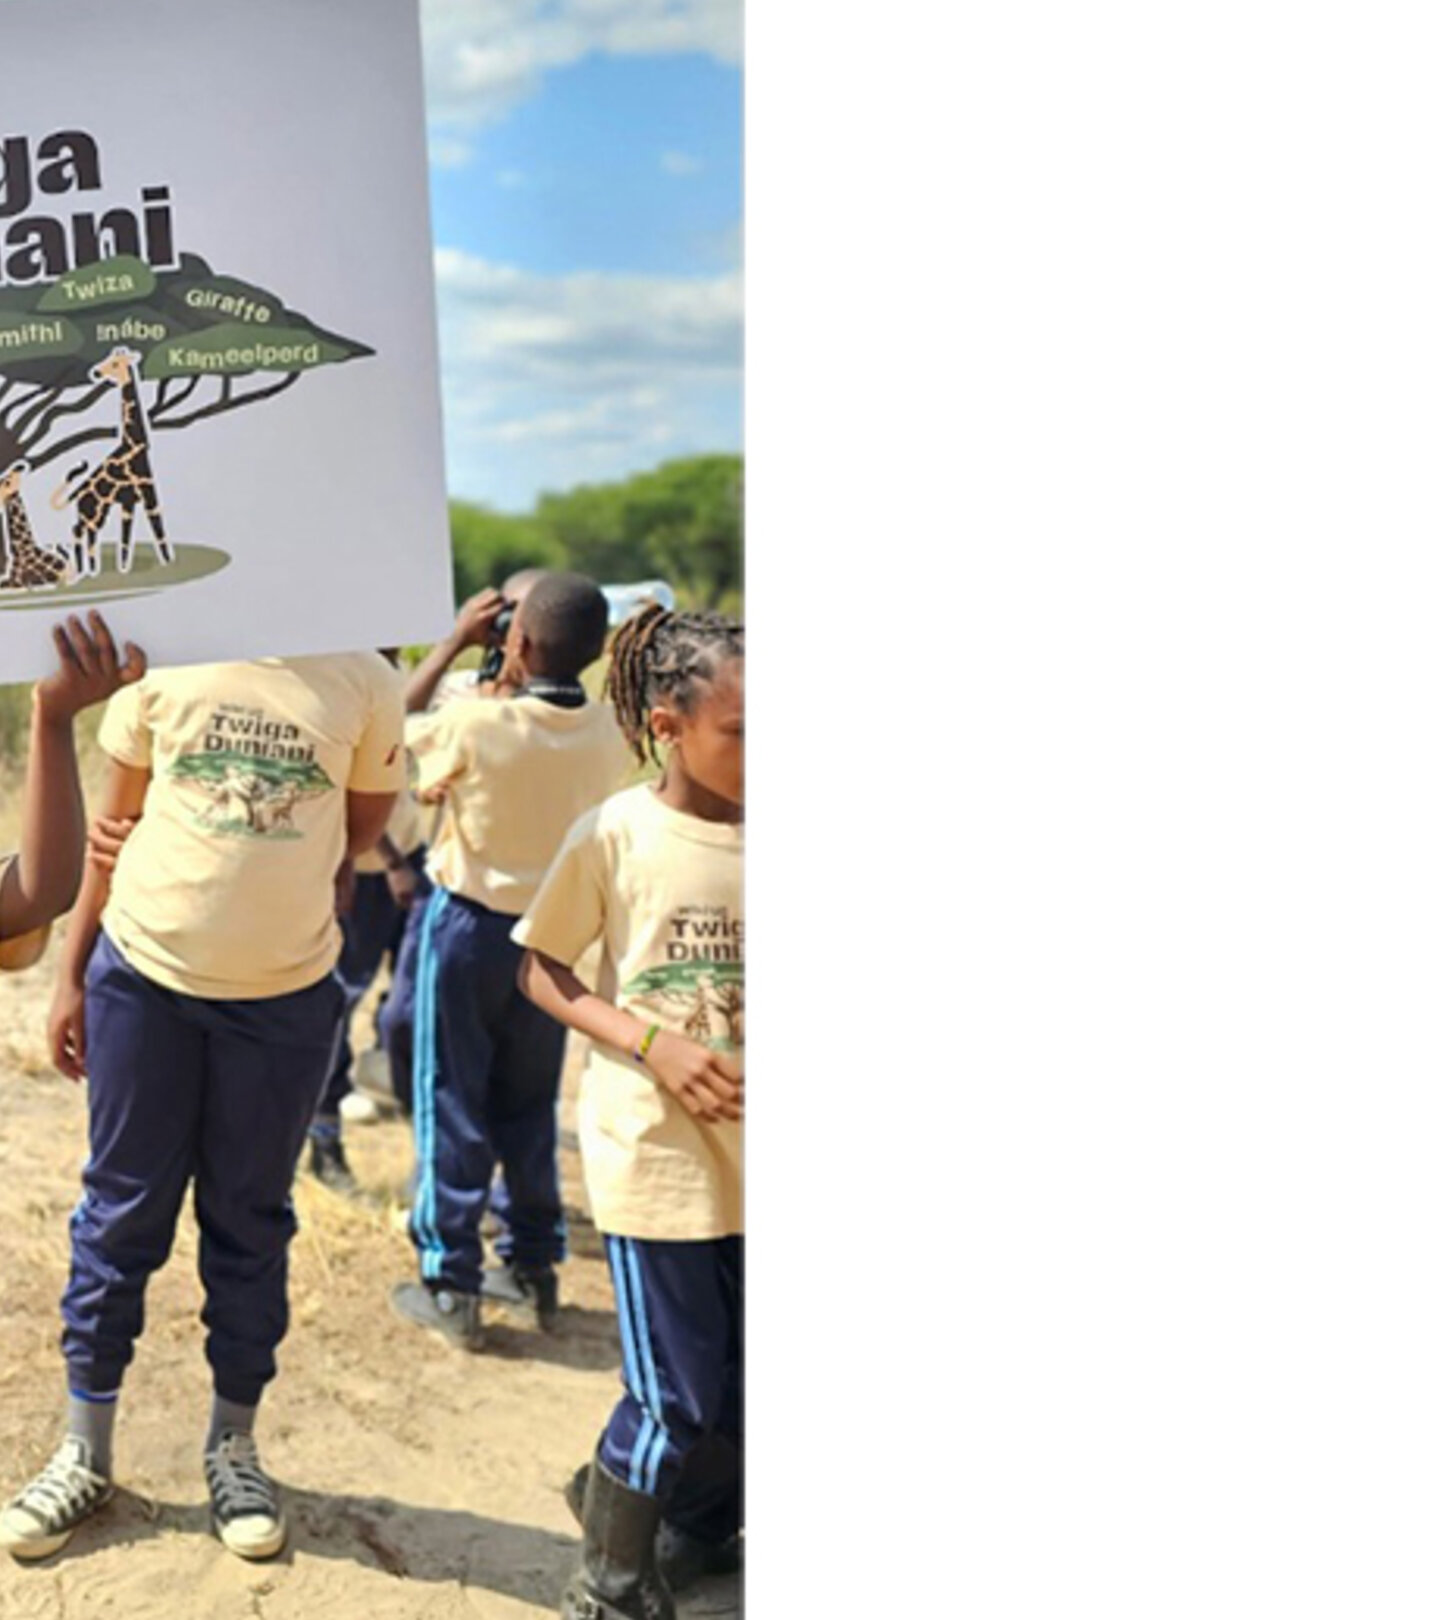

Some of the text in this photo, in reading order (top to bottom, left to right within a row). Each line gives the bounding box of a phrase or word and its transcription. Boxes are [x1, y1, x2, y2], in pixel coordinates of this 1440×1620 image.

[62, 272, 135, 301] Twiza
[185, 288, 272, 324] Giraffe
[168, 343, 319, 369] Kameelperd
[210, 713, 300, 741] Twiga
